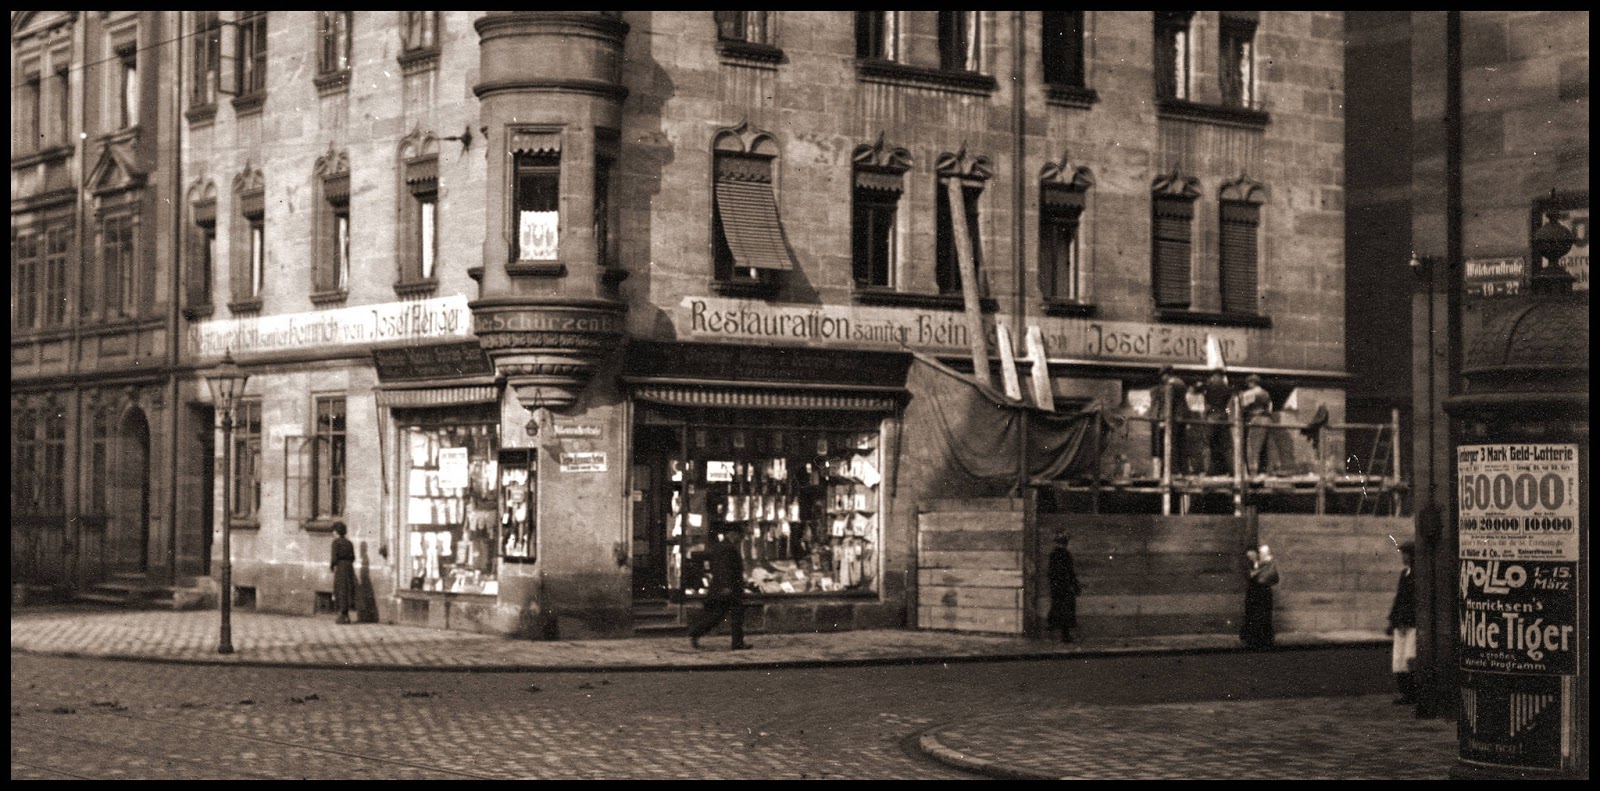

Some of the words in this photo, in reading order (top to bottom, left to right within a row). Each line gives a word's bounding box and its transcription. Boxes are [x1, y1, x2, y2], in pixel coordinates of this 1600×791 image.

[690, 300, 849, 338] Restauration
[1480, 448, 1486, 461] 3
[1487, 447, 1508, 461] Mark
[1510, 446, 1573, 461] Geld-Lotterie
[1480, 518, 1519, 531] 20000
[1525, 518, 1572, 531] 10000
[1534, 579, 1569, 590] März
[1502, 612, 1573, 661] Tiger
[1491, 660, 1546, 672] Programm
